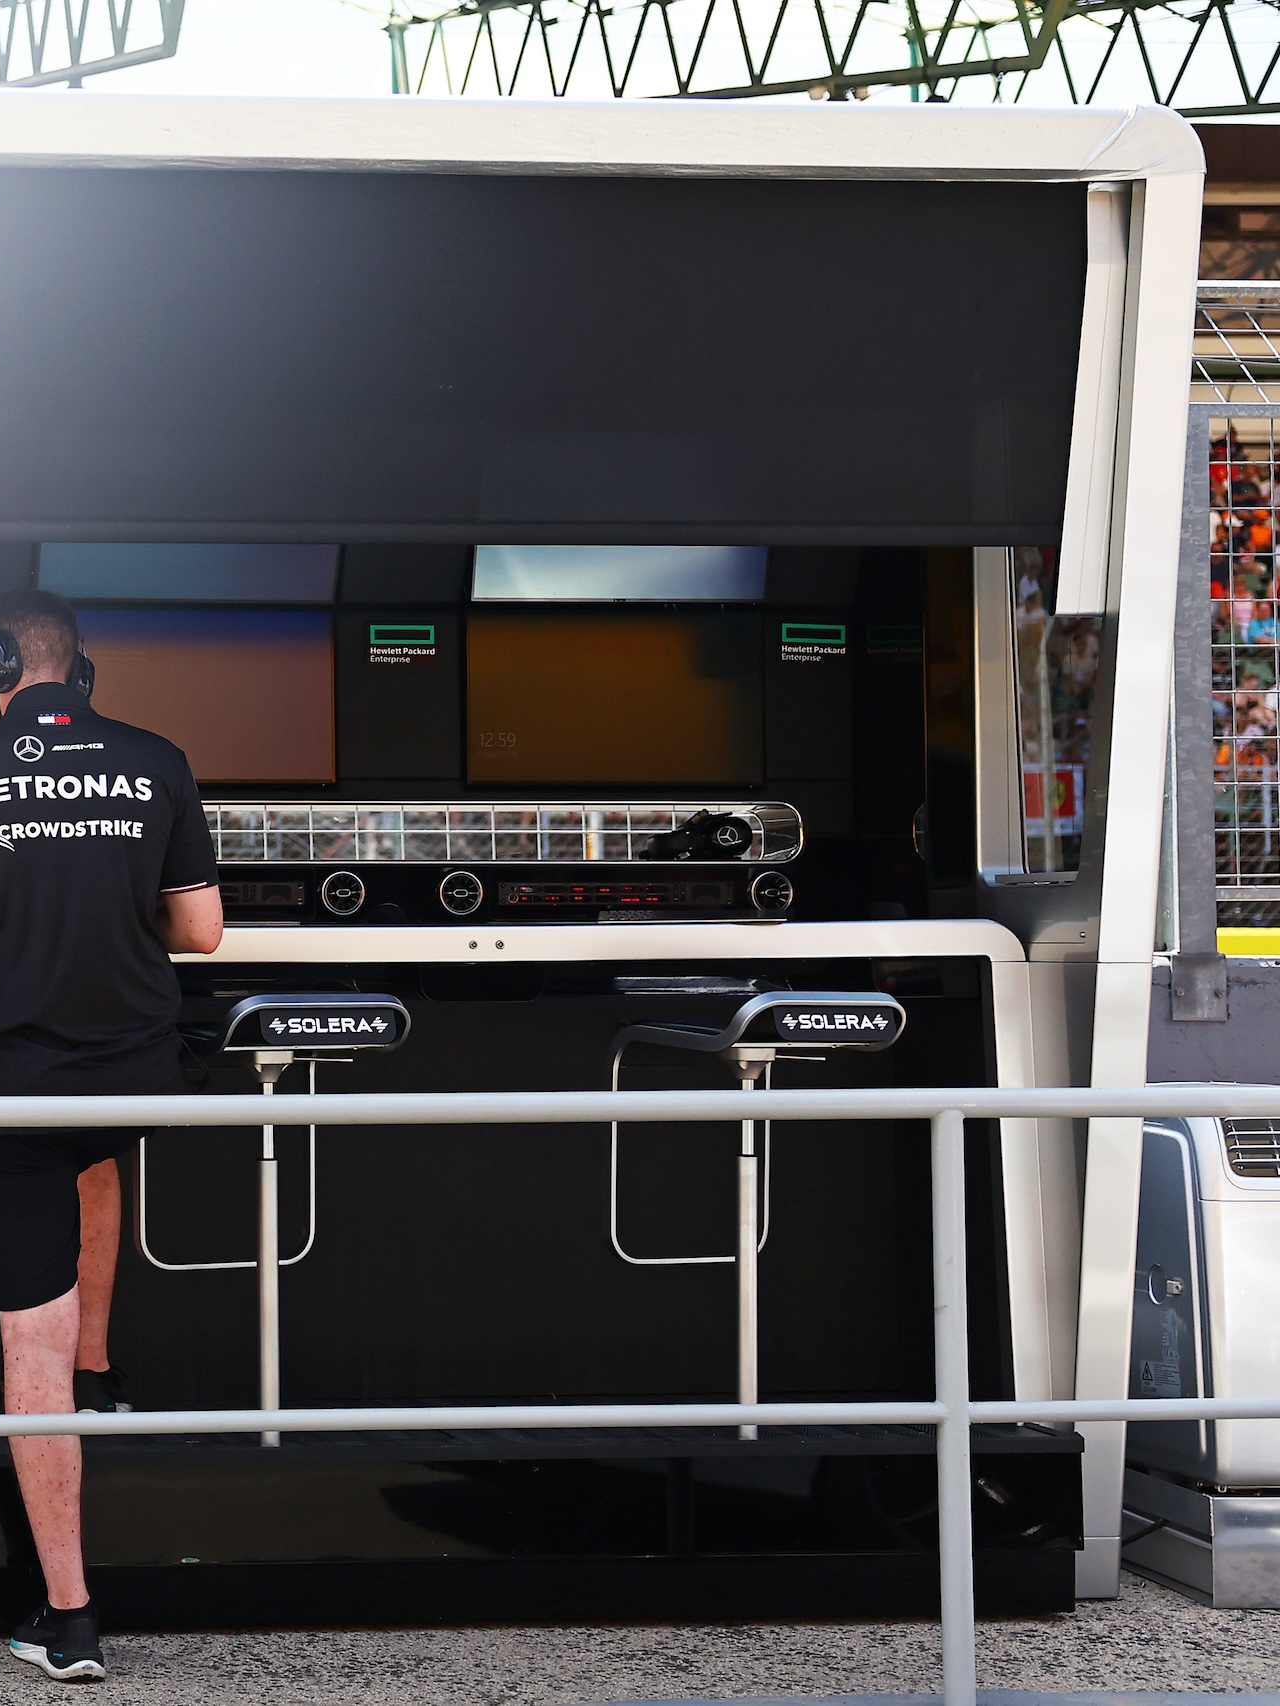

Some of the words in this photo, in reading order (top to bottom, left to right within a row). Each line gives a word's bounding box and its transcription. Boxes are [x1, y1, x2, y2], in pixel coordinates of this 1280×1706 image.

[370, 647, 402, 655] Hewlett
[402, 647, 436, 656] Packard
[781, 645, 813, 654] Hewlett
[813, 646, 846, 654] Packard
[370, 655, 411, 665] Enterprise
[781, 653, 822, 662] Enterprise
[479, 732, 516, 748] 12:59
[287, 1016, 373, 1034] SOLERA
[799, 1014, 876, 1031] SOLERA
